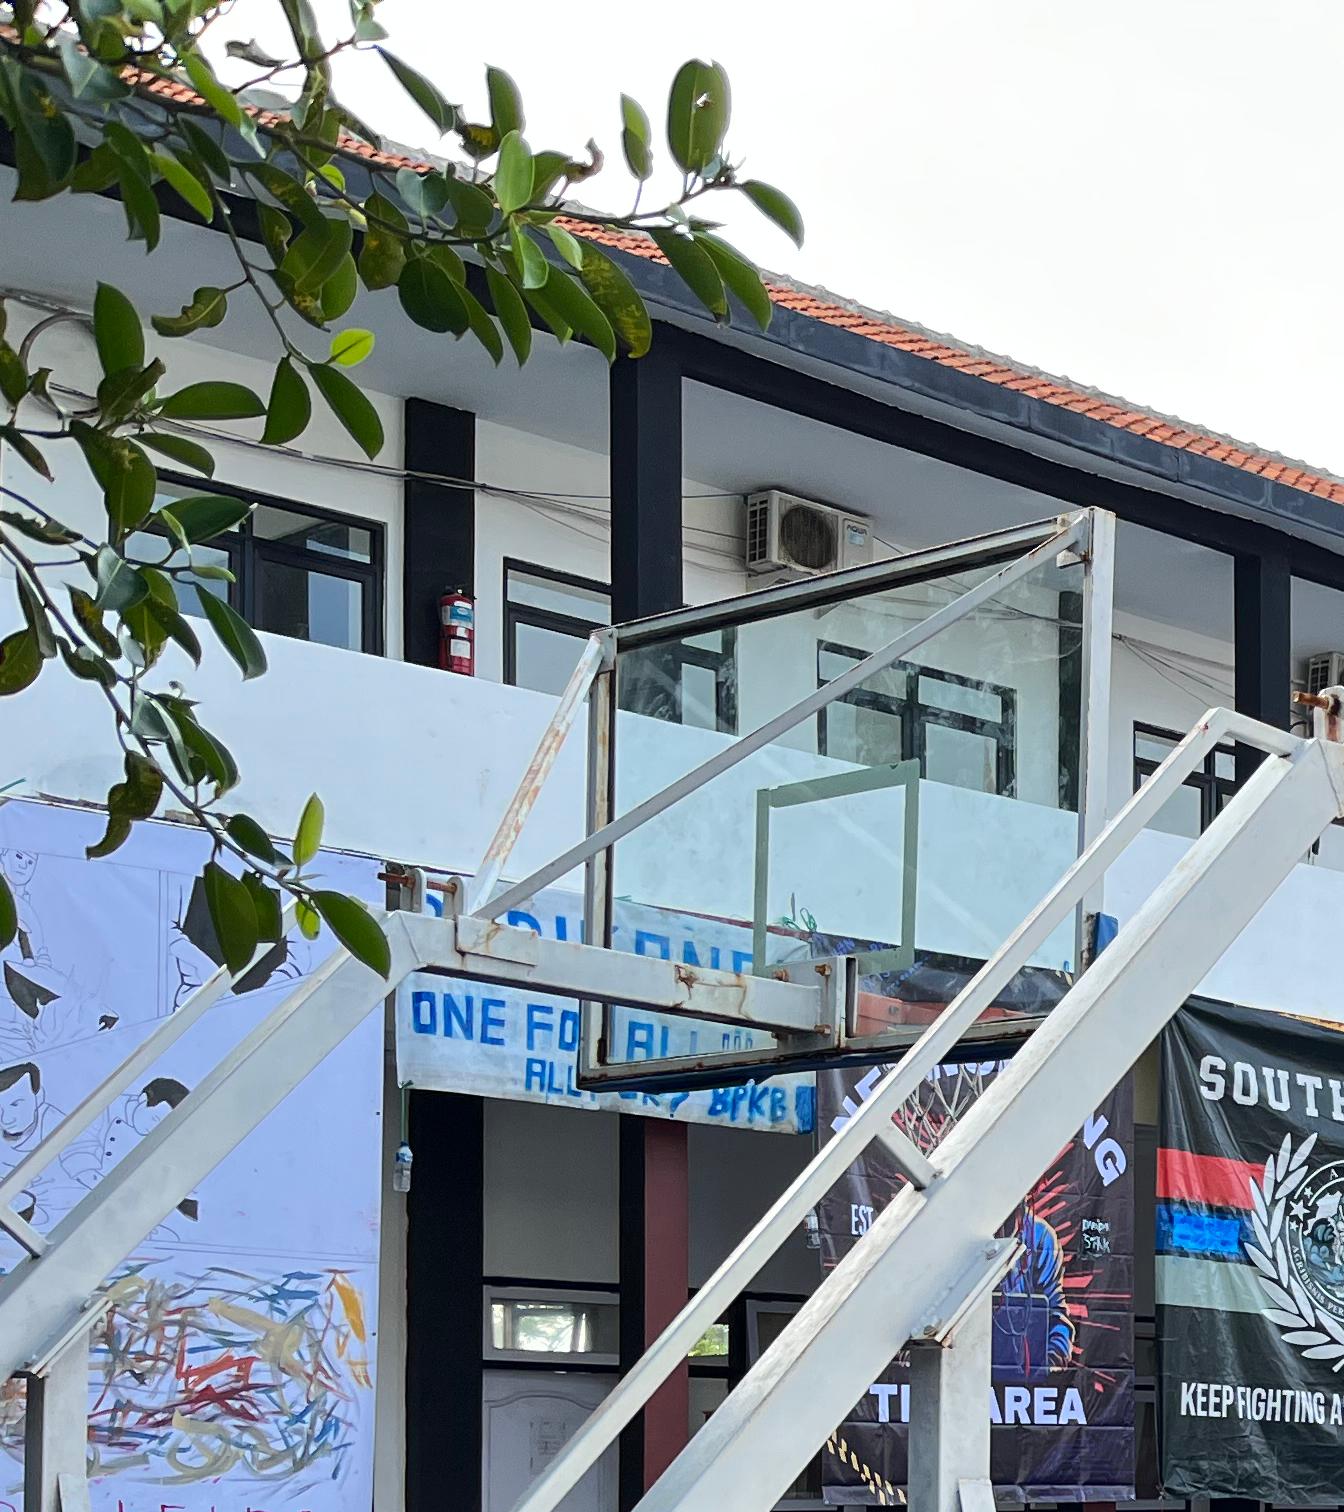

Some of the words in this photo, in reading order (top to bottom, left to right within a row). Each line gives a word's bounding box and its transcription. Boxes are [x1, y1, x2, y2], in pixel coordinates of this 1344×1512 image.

[411, 990, 506, 1047] ONE
[526, 1003, 578, 1052] FO
[1180, 1382, 1234, 1418] KEEP
[1236, 1386, 1325, 1426] FIGHTING
